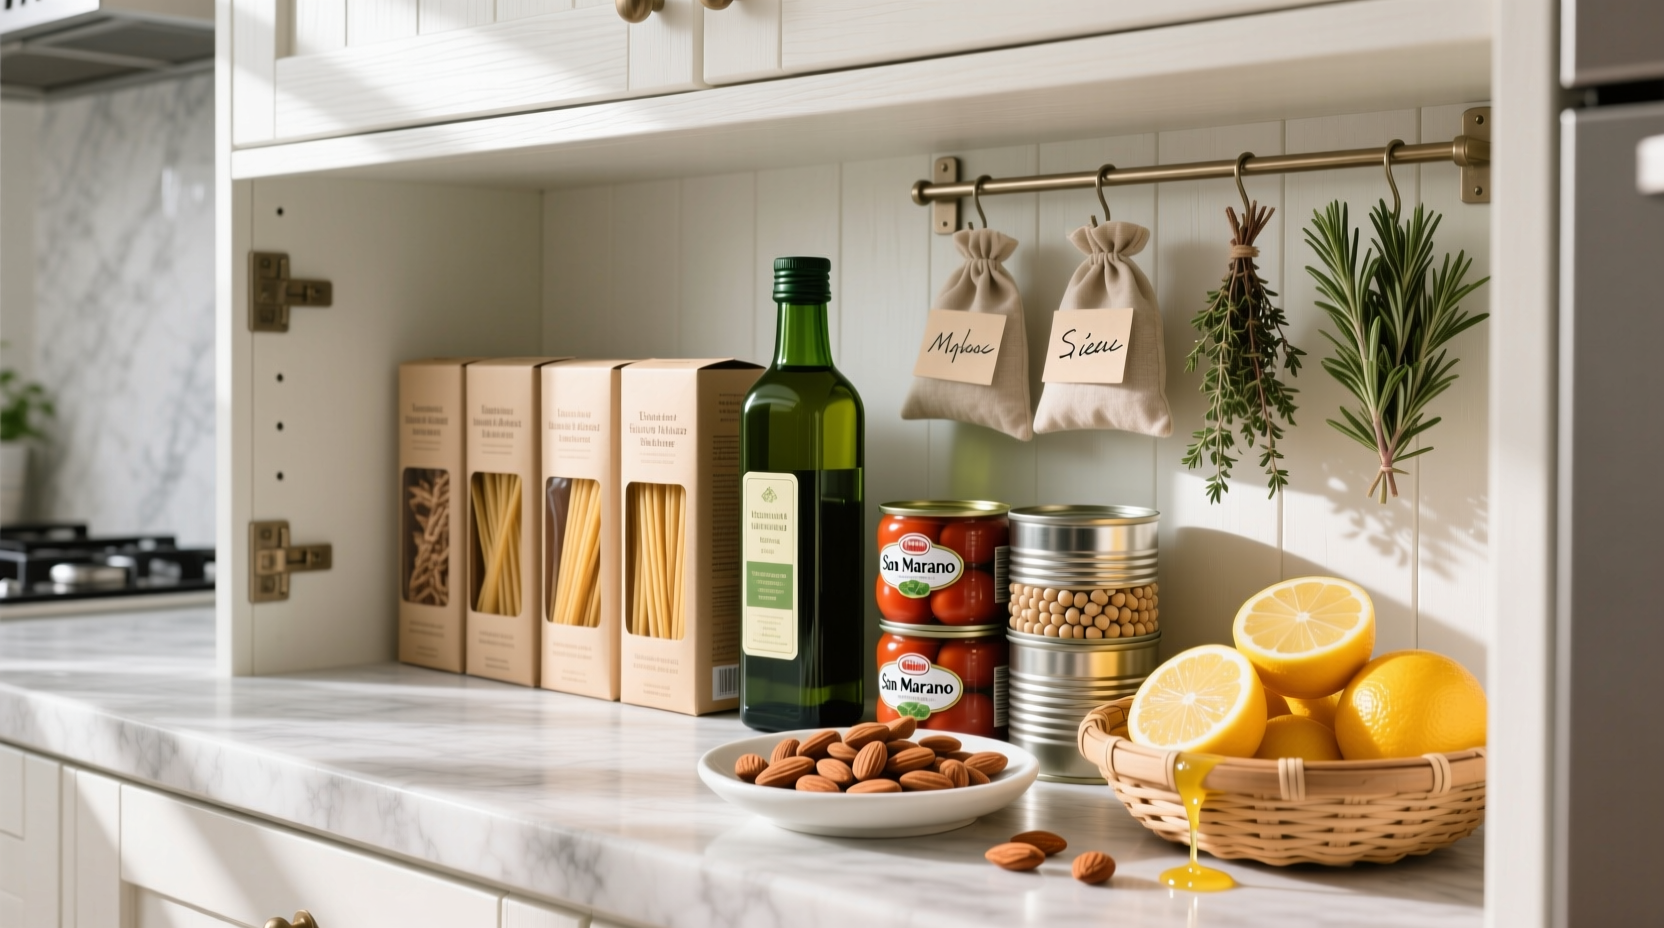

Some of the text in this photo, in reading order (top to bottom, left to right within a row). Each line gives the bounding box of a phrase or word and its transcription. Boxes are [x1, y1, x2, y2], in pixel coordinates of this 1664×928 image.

[882, 554, 956, 574] San Marano
[881, 672, 954, 695] San Marano
